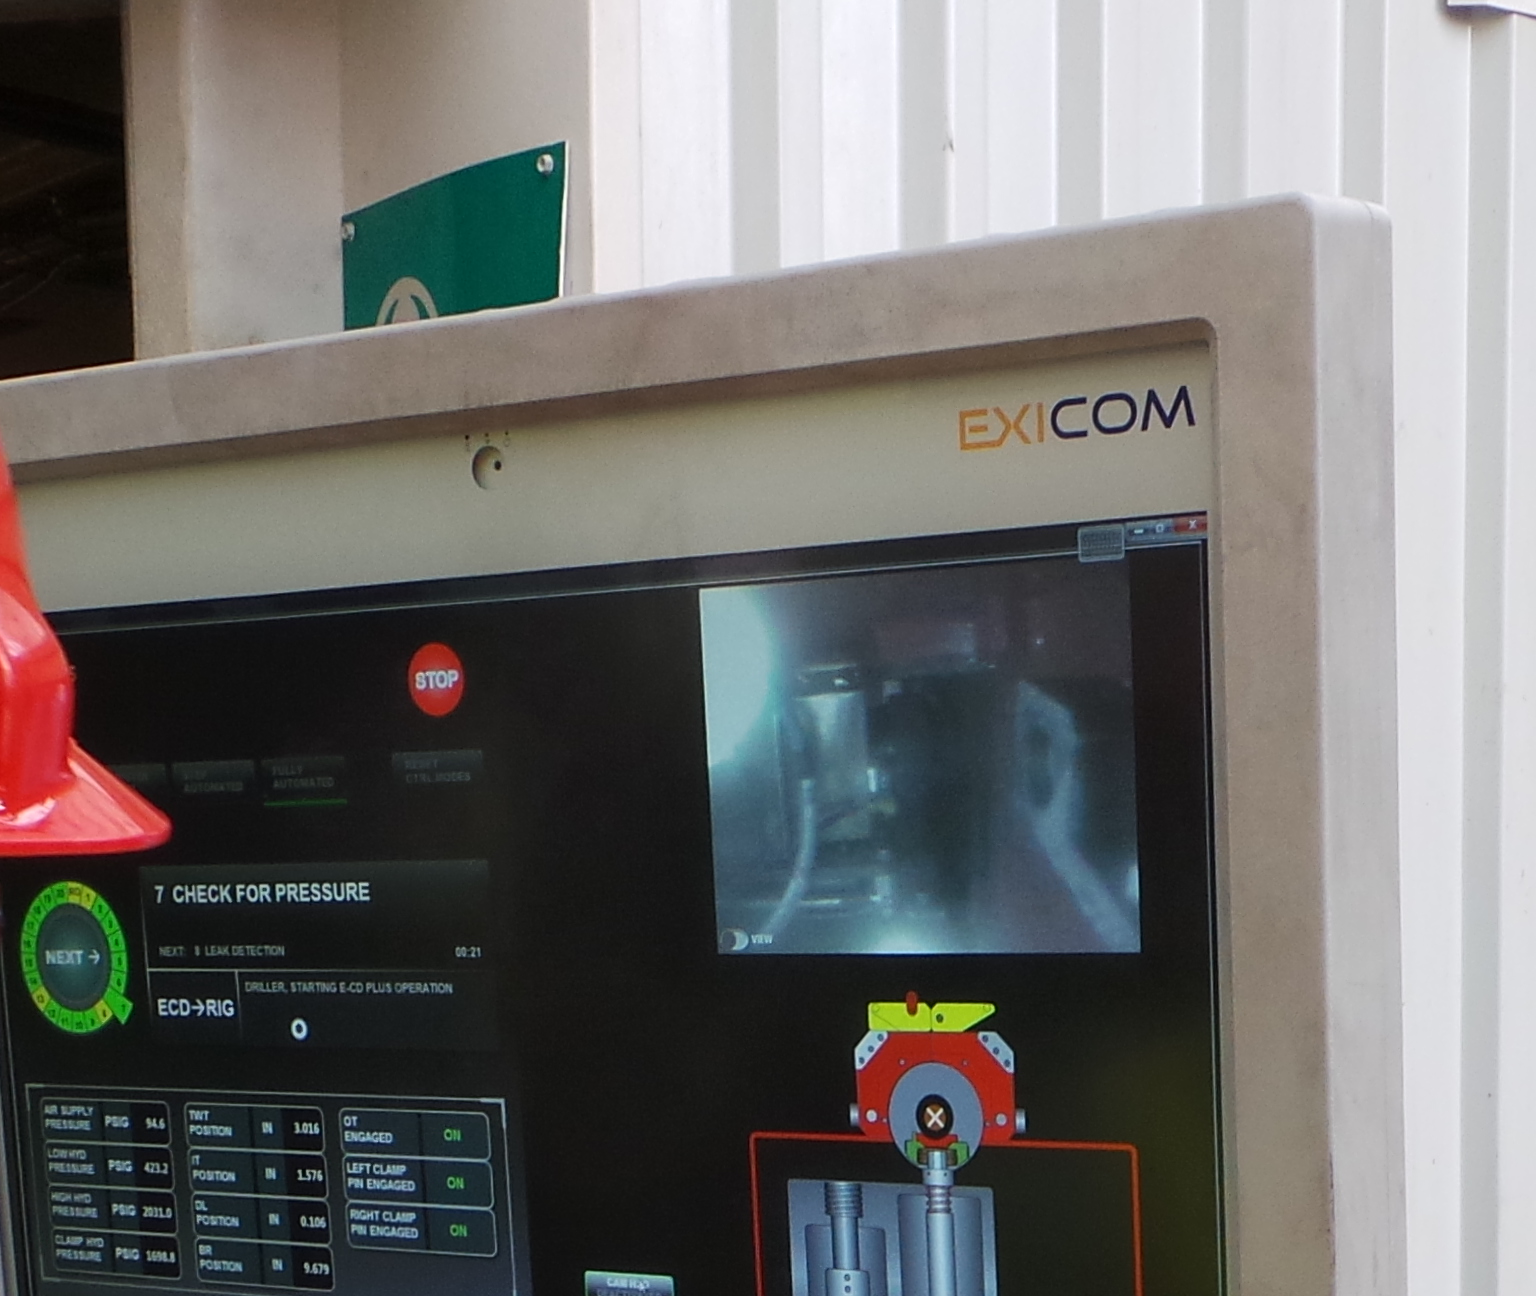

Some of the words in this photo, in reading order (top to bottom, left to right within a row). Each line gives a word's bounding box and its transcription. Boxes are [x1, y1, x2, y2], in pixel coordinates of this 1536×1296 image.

[958, 385, 1197, 451] EXICOM
[415, 669, 459, 690] STOP
[273, 776, 334, 789] AUTOMATED
[435, 771, 471, 782] MODES
[154, 885, 164, 904] 7
[172, 884, 233, 904] CHECK
[236, 883, 271, 903] FOR
[275, 882, 371, 902] PRESSURE
[751, 934, 773, 944] VIEW
[45, 949, 84, 965] NEXT
[205, 945, 230, 957] LEAK
[232, 945, 285, 957] DETECTION
[455, 946, 482, 958] 00:21
[290, 981, 337, 994] STARTING
[339, 981, 364, 994] E-CD
[366, 981, 393, 994] PLUS
[395, 982, 453, 995] OPERATION
[44, 1105, 58, 1115] AIR
[60, 1105, 94, 1116] SUPPLY
[188, 1109, 210, 1121] TWT
[45, 1118, 92, 1131] PRESSURE
[104, 1115, 130, 1128] PSIG
[145, 1117, 166, 1130] 94.6
[261, 1121, 274, 1135] IN
[343, 1115, 358, 1127] OT
[189, 1124, 233, 1137] POSITION
[293, 1122, 320, 1135] 3.016
[443, 1128, 461, 1142] ON
[344, 1130, 393, 1144] ENGAGED
[47, 1148, 68, 1159] LOW
[69, 1149, 87, 1160] HYD
[191, 1154, 200, 1166] IT
[48, 1162, 96, 1175] PRESSURE
[107, 1159, 133, 1173] PSIG
[143, 1162, 169, 1175] 423.2
[346, 1162, 371, 1175] LEFT
[372, 1163, 407, 1176] CLAMP
[192, 1169, 236, 1182] POSITION
[265, 1167, 277, 1180] IN
[297, 1168, 323, 1182] 1.576
[347, 1177, 364, 1189] PIN
[366, 1178, 416, 1192] ENGAGED
[446, 1176, 465, 1190] ON
[50, 1191, 72, 1203] HIGH
[73, 1192, 92, 1204] HYD
[51, 1205, 99, 1219] PRESSURE
[111, 1203, 137, 1217] PSIG
[142, 1206, 173, 1219] 2031.0
[349, 1208, 380, 1221] RIGHT
[382, 1210, 417, 1223] CLAMP
[196, 1214, 240, 1228] POSITION
[268, 1212, 281, 1226] IN
[300, 1215, 327, 1228] 0.106
[351, 1223, 367, 1236] PIN
[369, 1224, 419, 1239] ENGAGED
[449, 1224, 468, 1237] ON
[54, 1234, 84, 1246] CLAMP
[85, 1236, 105, 1248] HYD
[55, 1248, 102, 1263] PRESSURE
[115, 1247, 140, 1261] PSIG
[199, 1259, 243, 1273] POSITION
[271, 1258, 283, 1272] IN
[303, 1261, 330, 1275] 9.679
